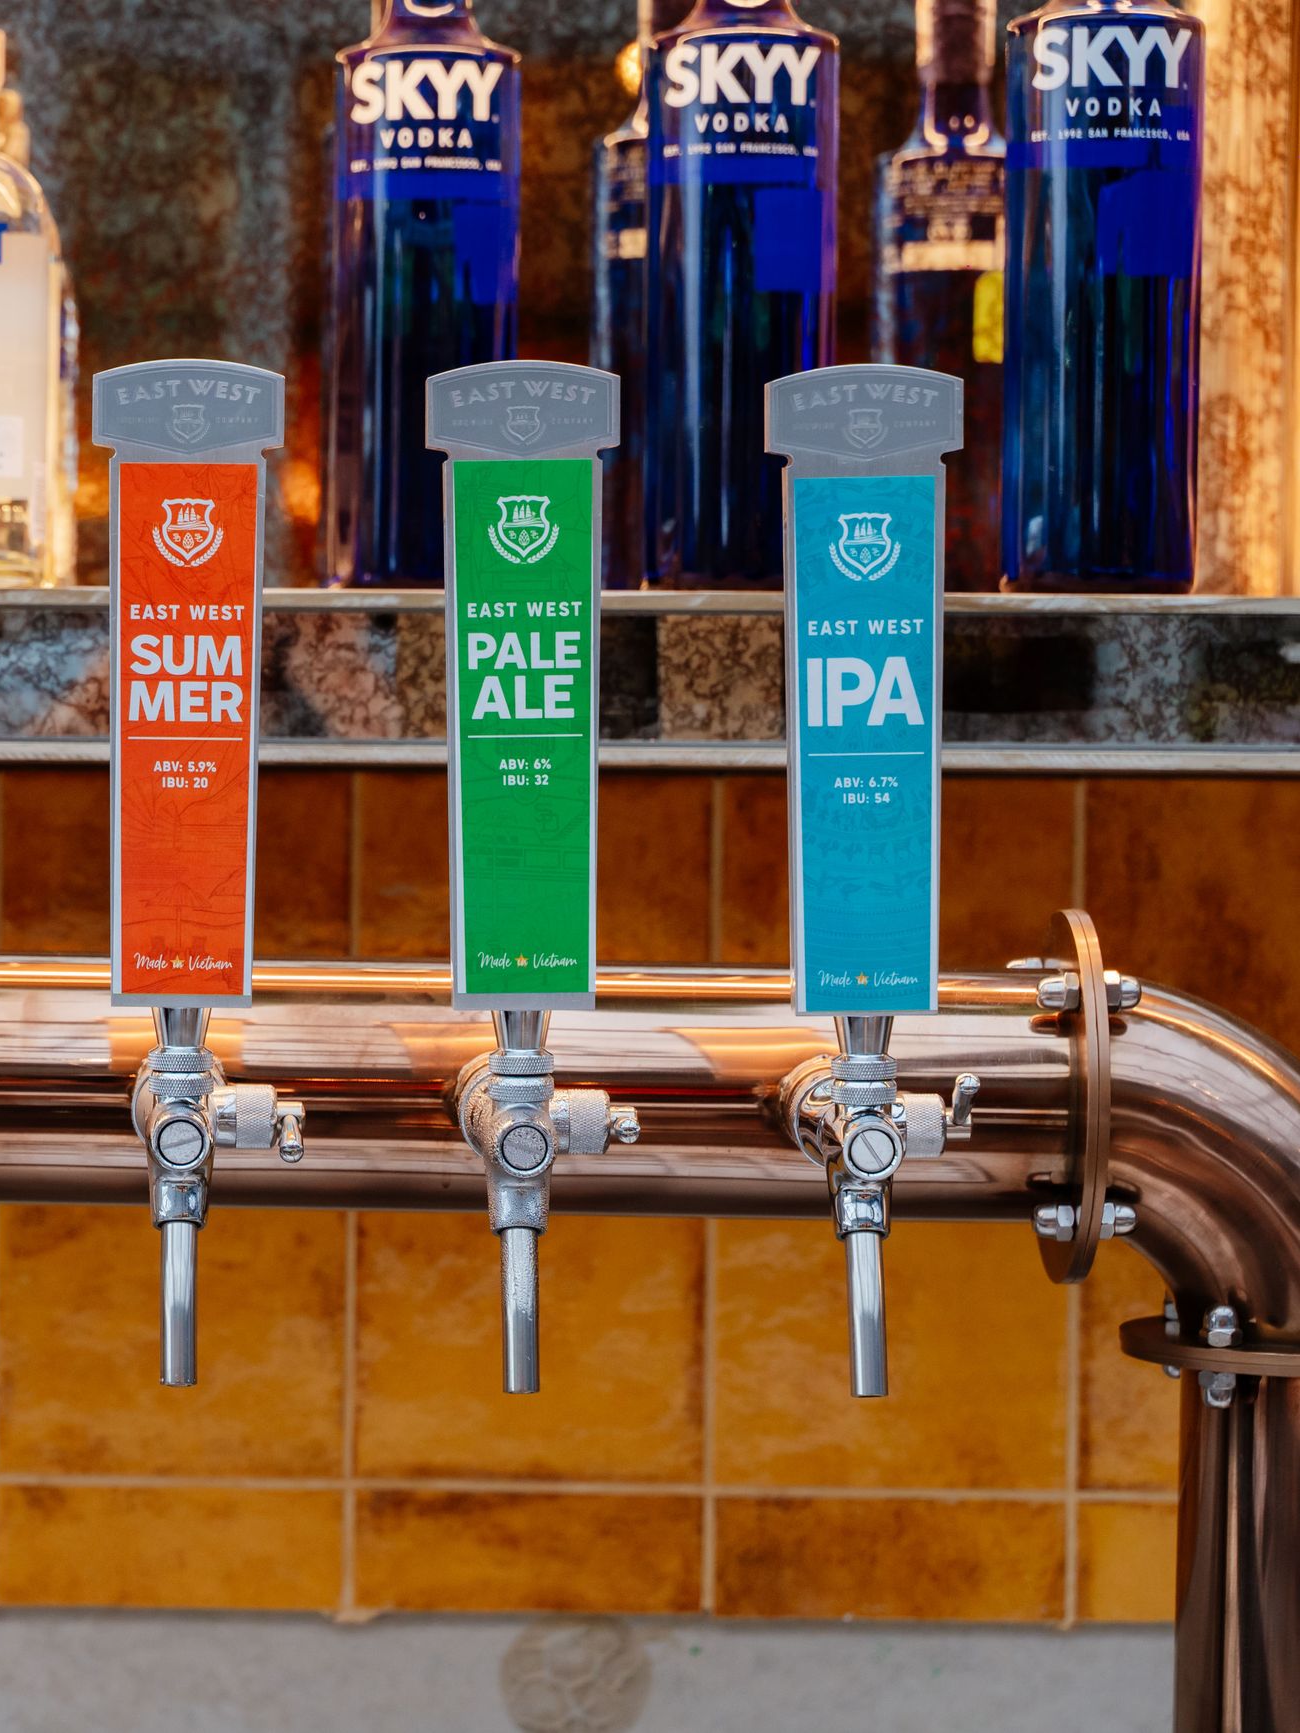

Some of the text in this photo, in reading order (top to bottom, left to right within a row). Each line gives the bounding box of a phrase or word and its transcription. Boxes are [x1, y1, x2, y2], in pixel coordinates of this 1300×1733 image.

[1031, 26, 1193, 91] SKYY
[664, 43, 821, 108] SKYY
[350, 60, 504, 124] SKYY
[1065, 97, 1161, 118] VODKA
[695, 112, 789, 133] VODKA
[1088, 127, 1108, 138] SAN
[380, 127, 473, 149] VODKA
[116, 379, 261, 405] EAST WEST
[451, 380, 596, 408] EAST WEST
[793, 383, 938, 411] EAST WEST
[130, 604, 245, 621] EAST WEST
[467, 601, 582, 618] EAST WEST
[807, 618, 924, 636] EAST WEST
[130, 634, 243, 676] SUM
[467, 631, 581, 670] PALE
[129, 680, 243, 723] MER
[471, 675, 575, 720] ALE
[807, 656, 925, 727] IPA
[153, 760, 217, 773] ABV: 5.9%
[499, 758, 551, 770] ABV: 6%
[162, 777, 208, 789] IBU: 20
[502, 774, 549, 786] IBU: 32
[834, 776, 898, 789] ABV: 6.7%
[843, 792, 890, 804] IBU: 54
[134, 952, 168, 970] Made
[188, 955, 233, 971] Vietnam
[477, 951, 512, 969] Made
[533, 952, 577, 969] Vietnam
[818, 969, 853, 987] Made
[874, 971, 918, 987] Vietnam
